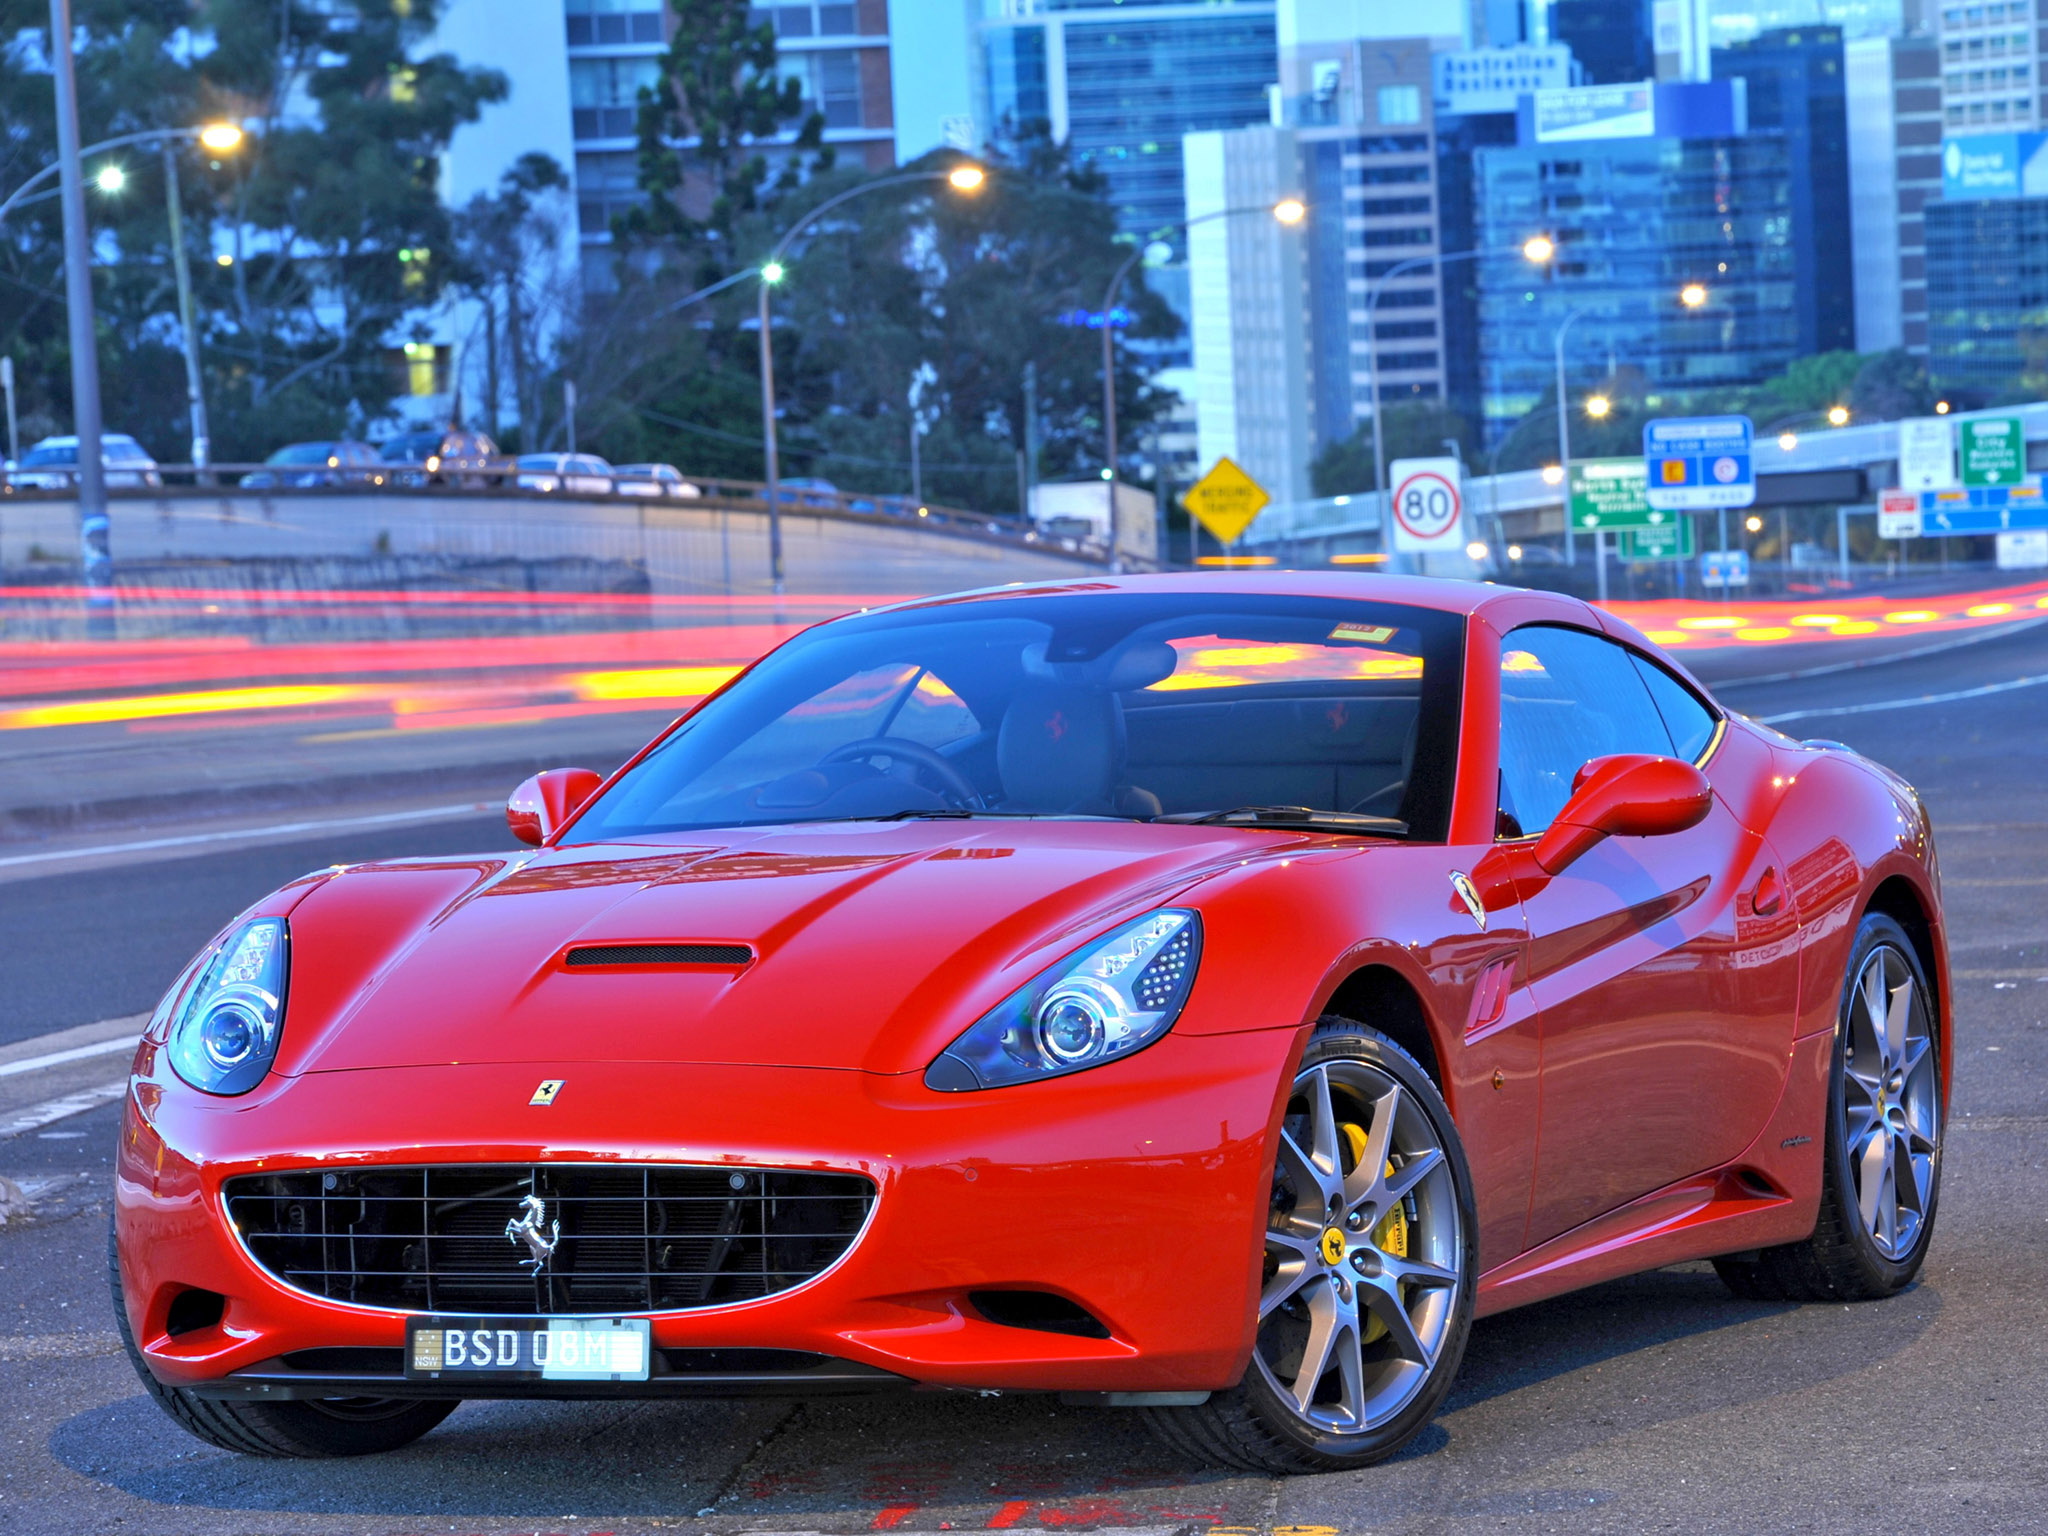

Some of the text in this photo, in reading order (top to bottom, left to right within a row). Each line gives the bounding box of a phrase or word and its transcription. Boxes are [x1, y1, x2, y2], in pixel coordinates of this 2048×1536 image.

[1406, 488, 1449, 521] 80
[415, 1356, 438, 1366] NSW
[445, 1329, 606, 1366] BSD 08M
